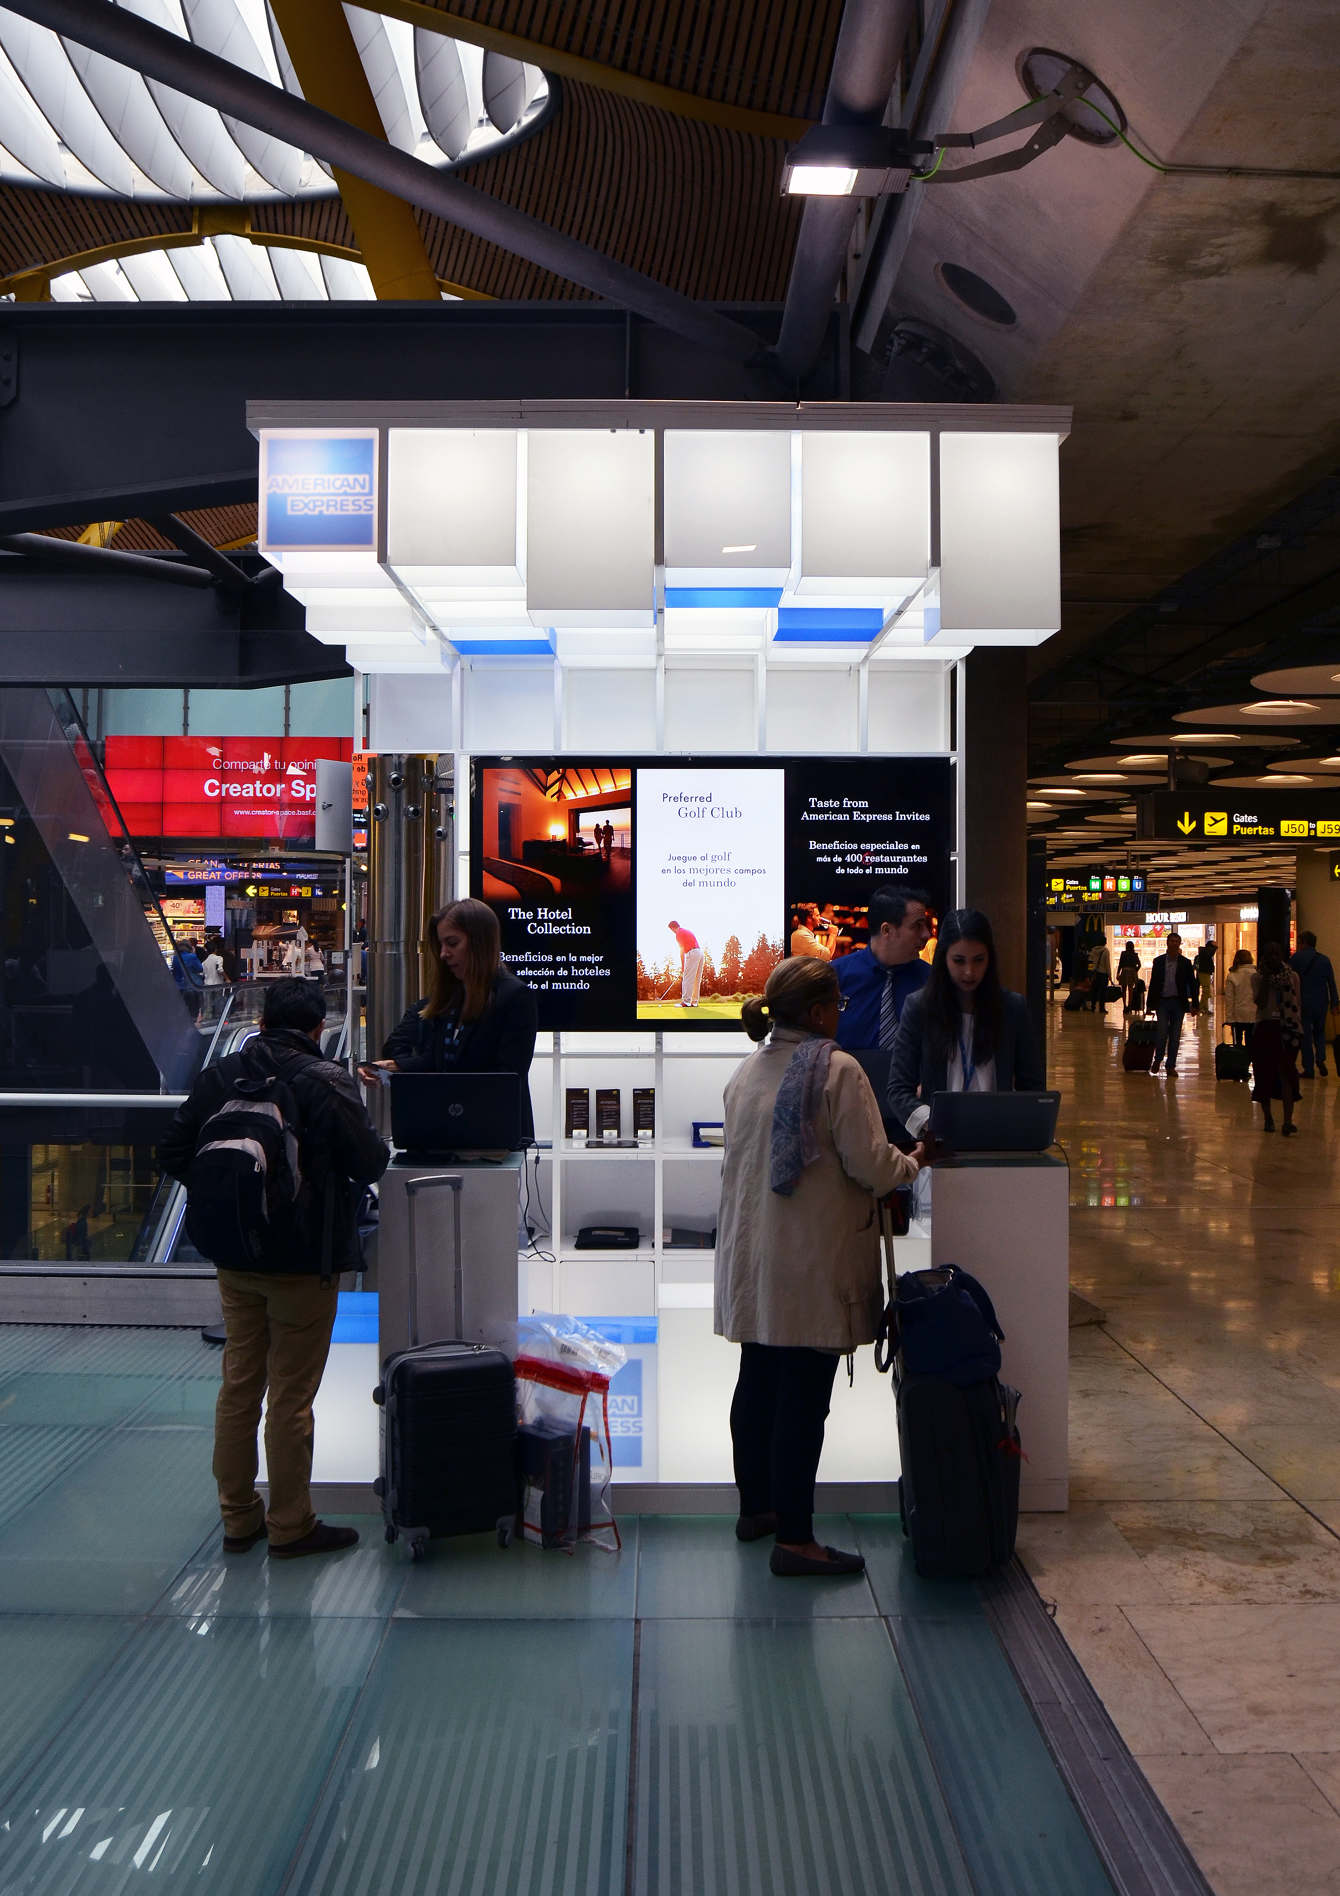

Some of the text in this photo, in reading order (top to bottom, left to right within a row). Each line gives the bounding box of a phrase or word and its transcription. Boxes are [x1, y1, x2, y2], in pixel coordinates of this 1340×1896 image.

[267, 475, 369, 493] AMERICAN
[288, 497, 374, 514] EXPRESS
[274, 760, 286, 769] tu
[203, 778, 285, 797] Creator
[662, 791, 712, 803] Preferred
[808, 797, 869, 808] Taste from
[677, 806, 742, 818] Golf Club
[800, 811, 931, 822] American Express Invites
[1232, 813, 1258, 823] Gates
[1232, 824, 1275, 835] Puertas
[1283, 823, 1305, 834] J50
[1320, 823, 1340, 834] J59
[808, 841, 858, 850] Beneficios
[860, 841, 909, 851] especiales
[667, 851, 732, 863] Juegue al golf
[832, 854, 843, 862] de
[844, 854, 863, 862] 400
[865, 853, 928, 862] restaurantes
[674, 866, 686, 874] los
[689, 865, 732, 876] mejores
[734, 868, 767, 876] campos
[835, 865, 909, 874] de todo el mundo
[187, 871, 221, 880] GREAT
[682, 878, 737, 887] del mundo
[1091, 881, 1100, 889] M
[1106, 881, 1113, 889] R
[1121, 881, 1128, 889] S
[1135, 881, 1142, 890] U
[507, 907, 572, 920] The Hotel
[526, 922, 592, 935] Collection
[499, 952, 553, 962] Beneficios
[568, 953, 577, 962] la
[579, 953, 604, 964] mejor
[516, 966, 611, 976] selección de hoteles
[540, 981, 549, 990] el
[551, 980, 590, 990] mundo
